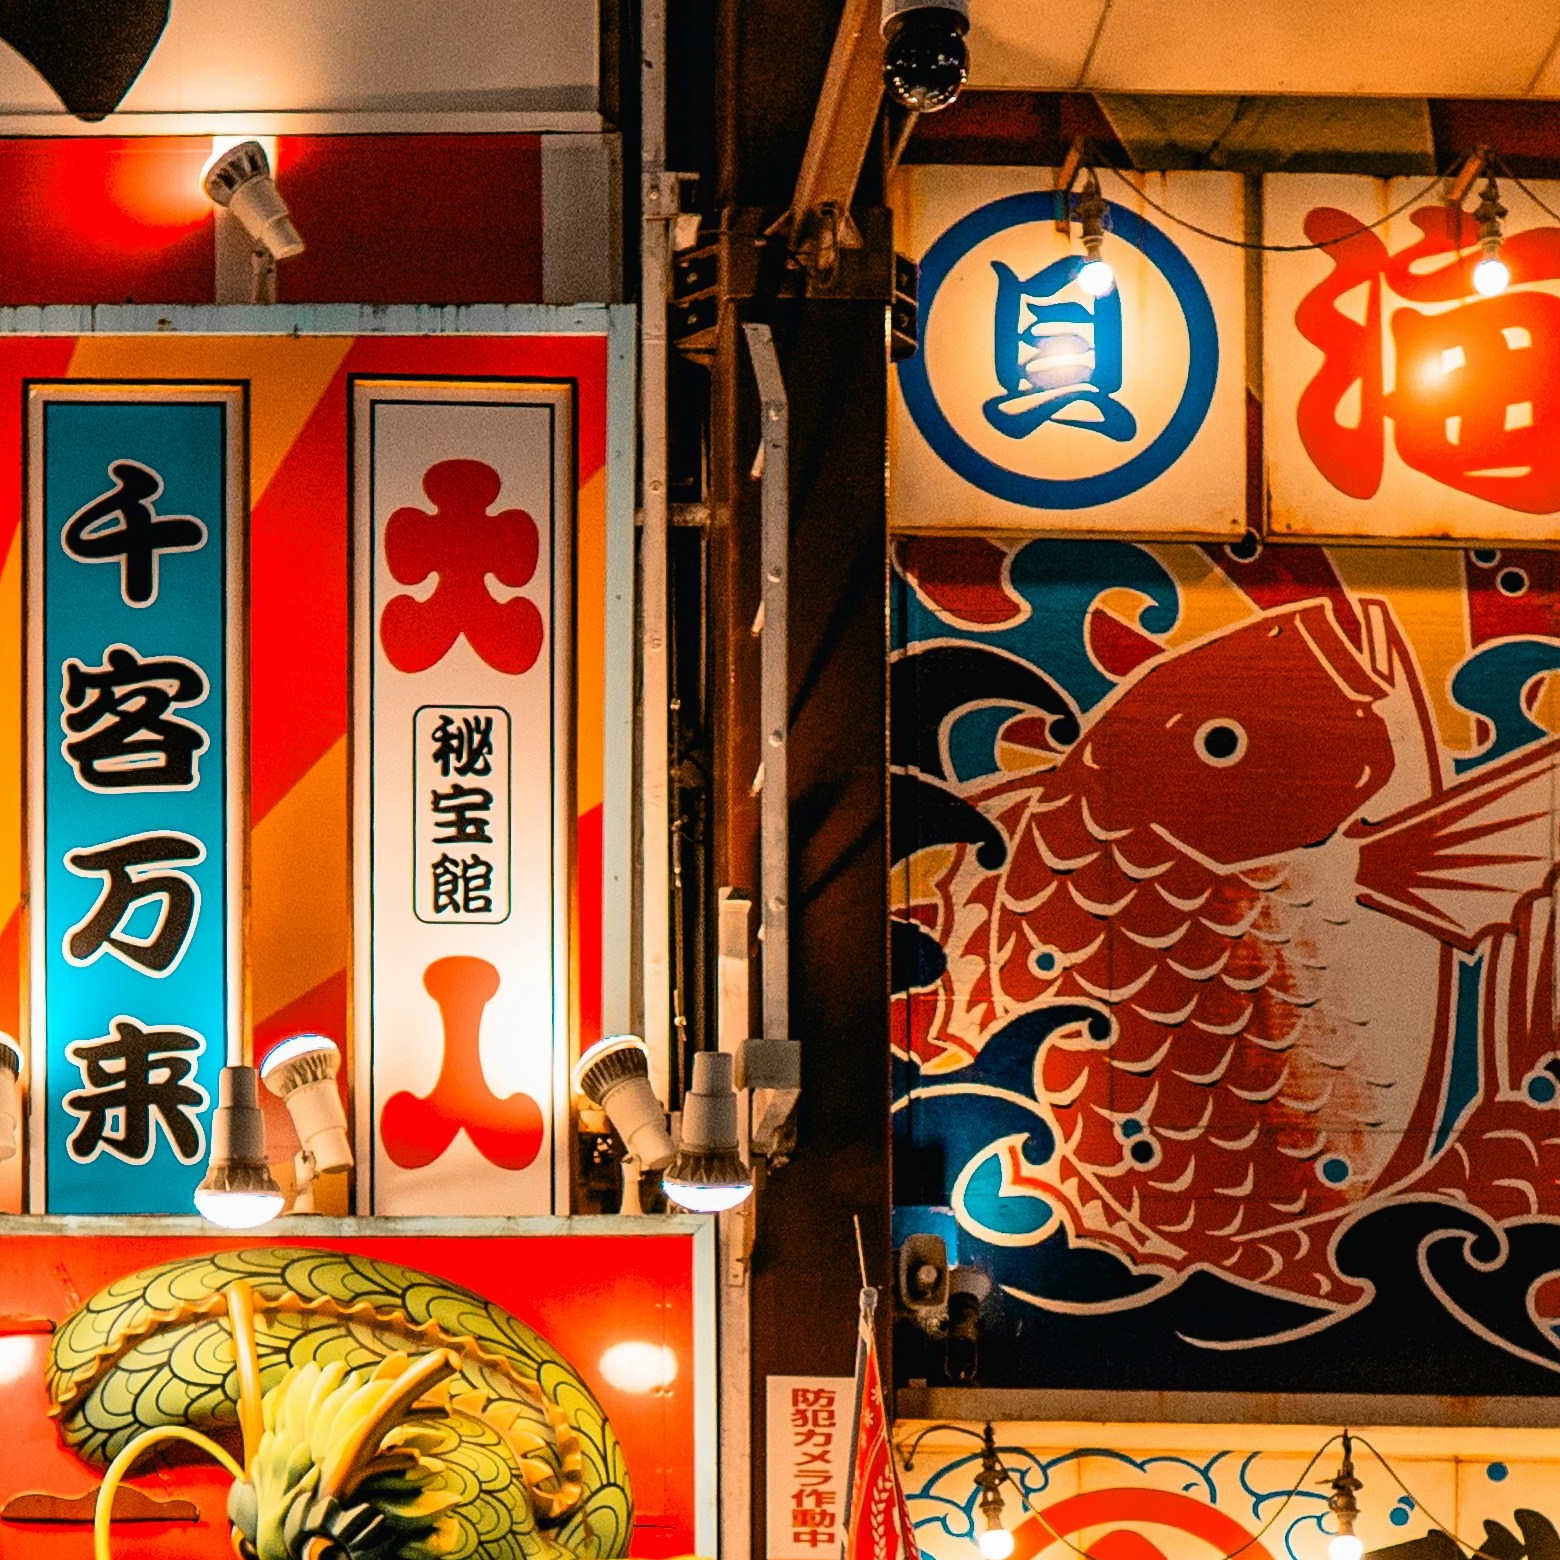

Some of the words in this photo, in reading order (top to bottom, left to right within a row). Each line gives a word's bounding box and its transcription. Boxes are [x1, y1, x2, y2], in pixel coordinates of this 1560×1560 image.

[60, 459, 209, 1166] 千客万来
[430, 713, 494, 916] 秘宝館
[790, 1386, 837, 1548] 防犯カメラ作動中
